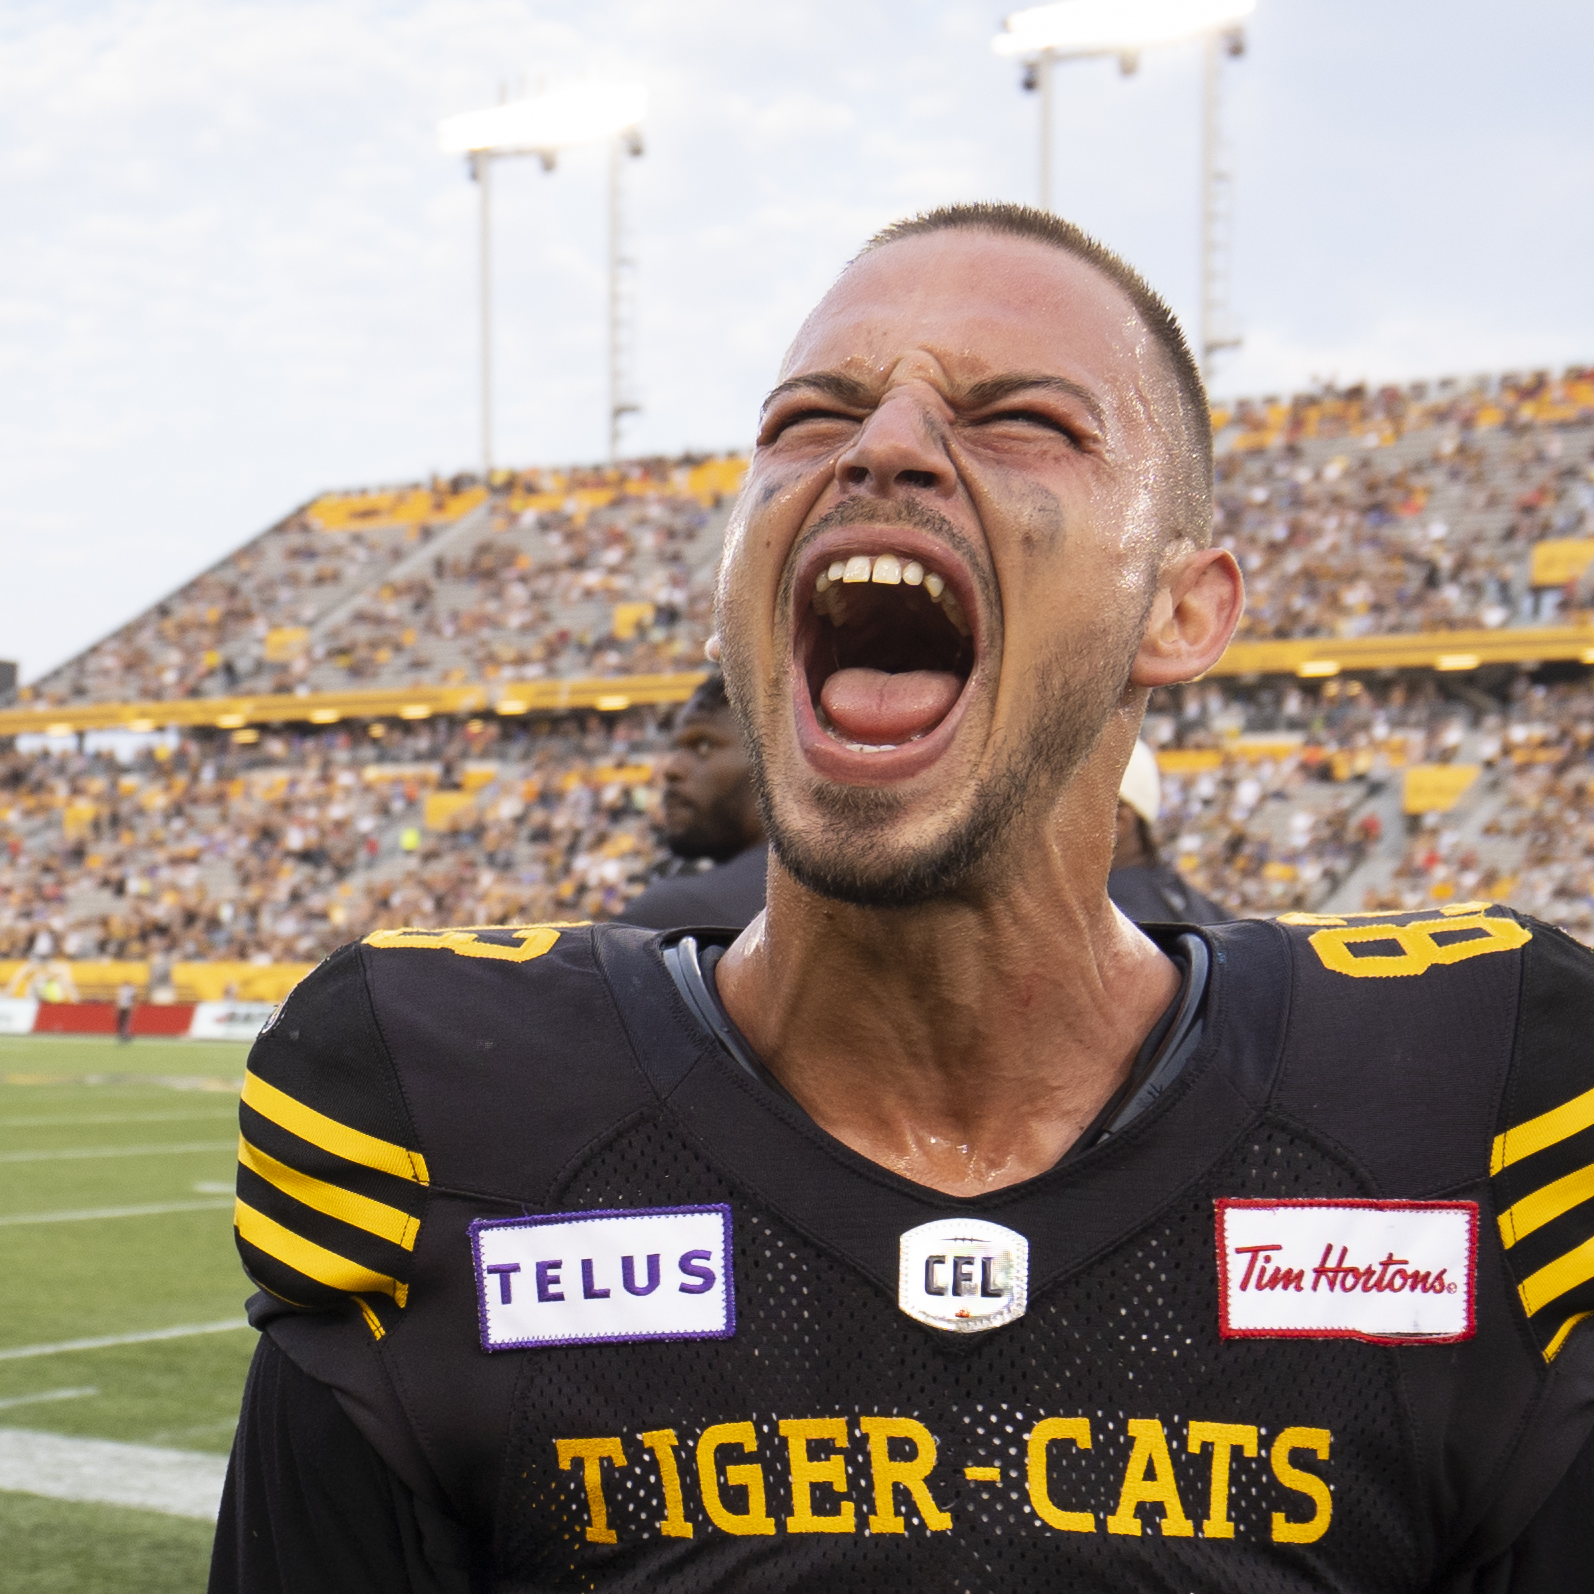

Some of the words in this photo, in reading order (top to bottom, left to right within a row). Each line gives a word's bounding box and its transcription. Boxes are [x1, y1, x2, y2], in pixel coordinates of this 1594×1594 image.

[362, 920, 593, 963] 3
[1277, 900, 1533, 978] 8
[486, 1249, 717, 1305] TELUS
[924, 1255, 1009, 1298] CFL
[1235, 1244, 1305, 1292] Tim
[555, 1415, 1334, 1545] TIGER-CATS
